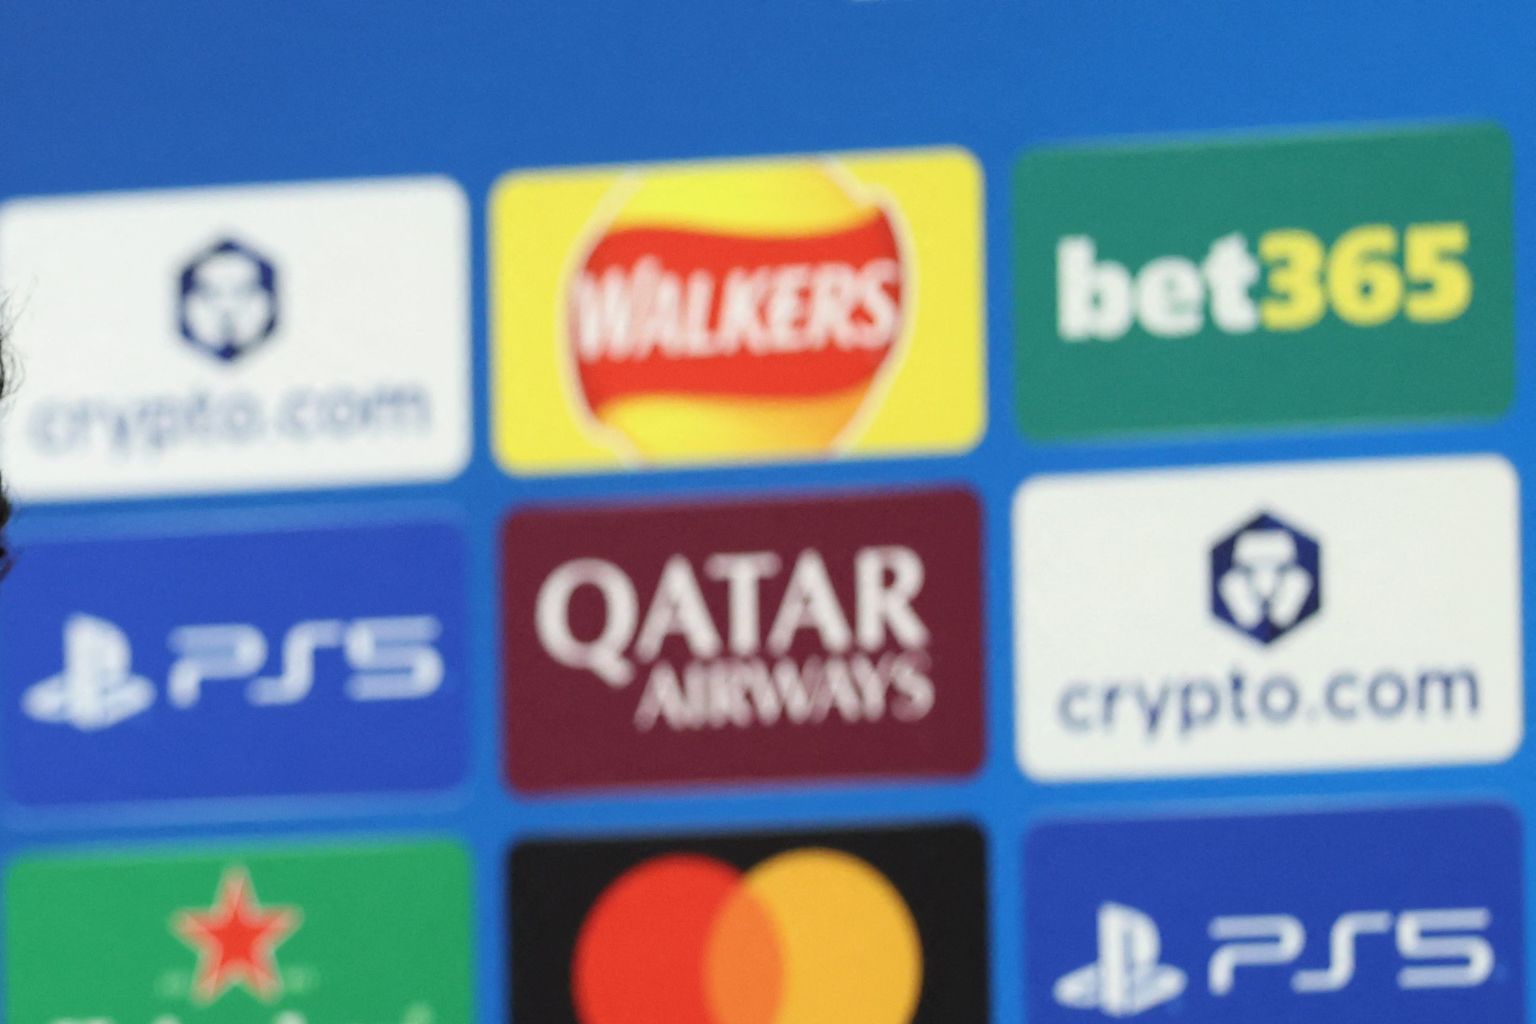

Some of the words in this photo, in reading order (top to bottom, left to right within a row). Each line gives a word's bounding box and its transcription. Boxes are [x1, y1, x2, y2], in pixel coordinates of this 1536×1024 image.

[570, 254, 900, 363] WALKERS
[1056, 222, 1472, 341] bet365
[27, 382, 434, 460] crypto.com
[167, 615, 445, 709] PS5
[534, 544, 930, 689] QATAR
[633, 651, 935, 733] AIRWAYS
[1056, 664, 1480, 742] crypto.com
[1207, 907, 1495, 996] PS5
